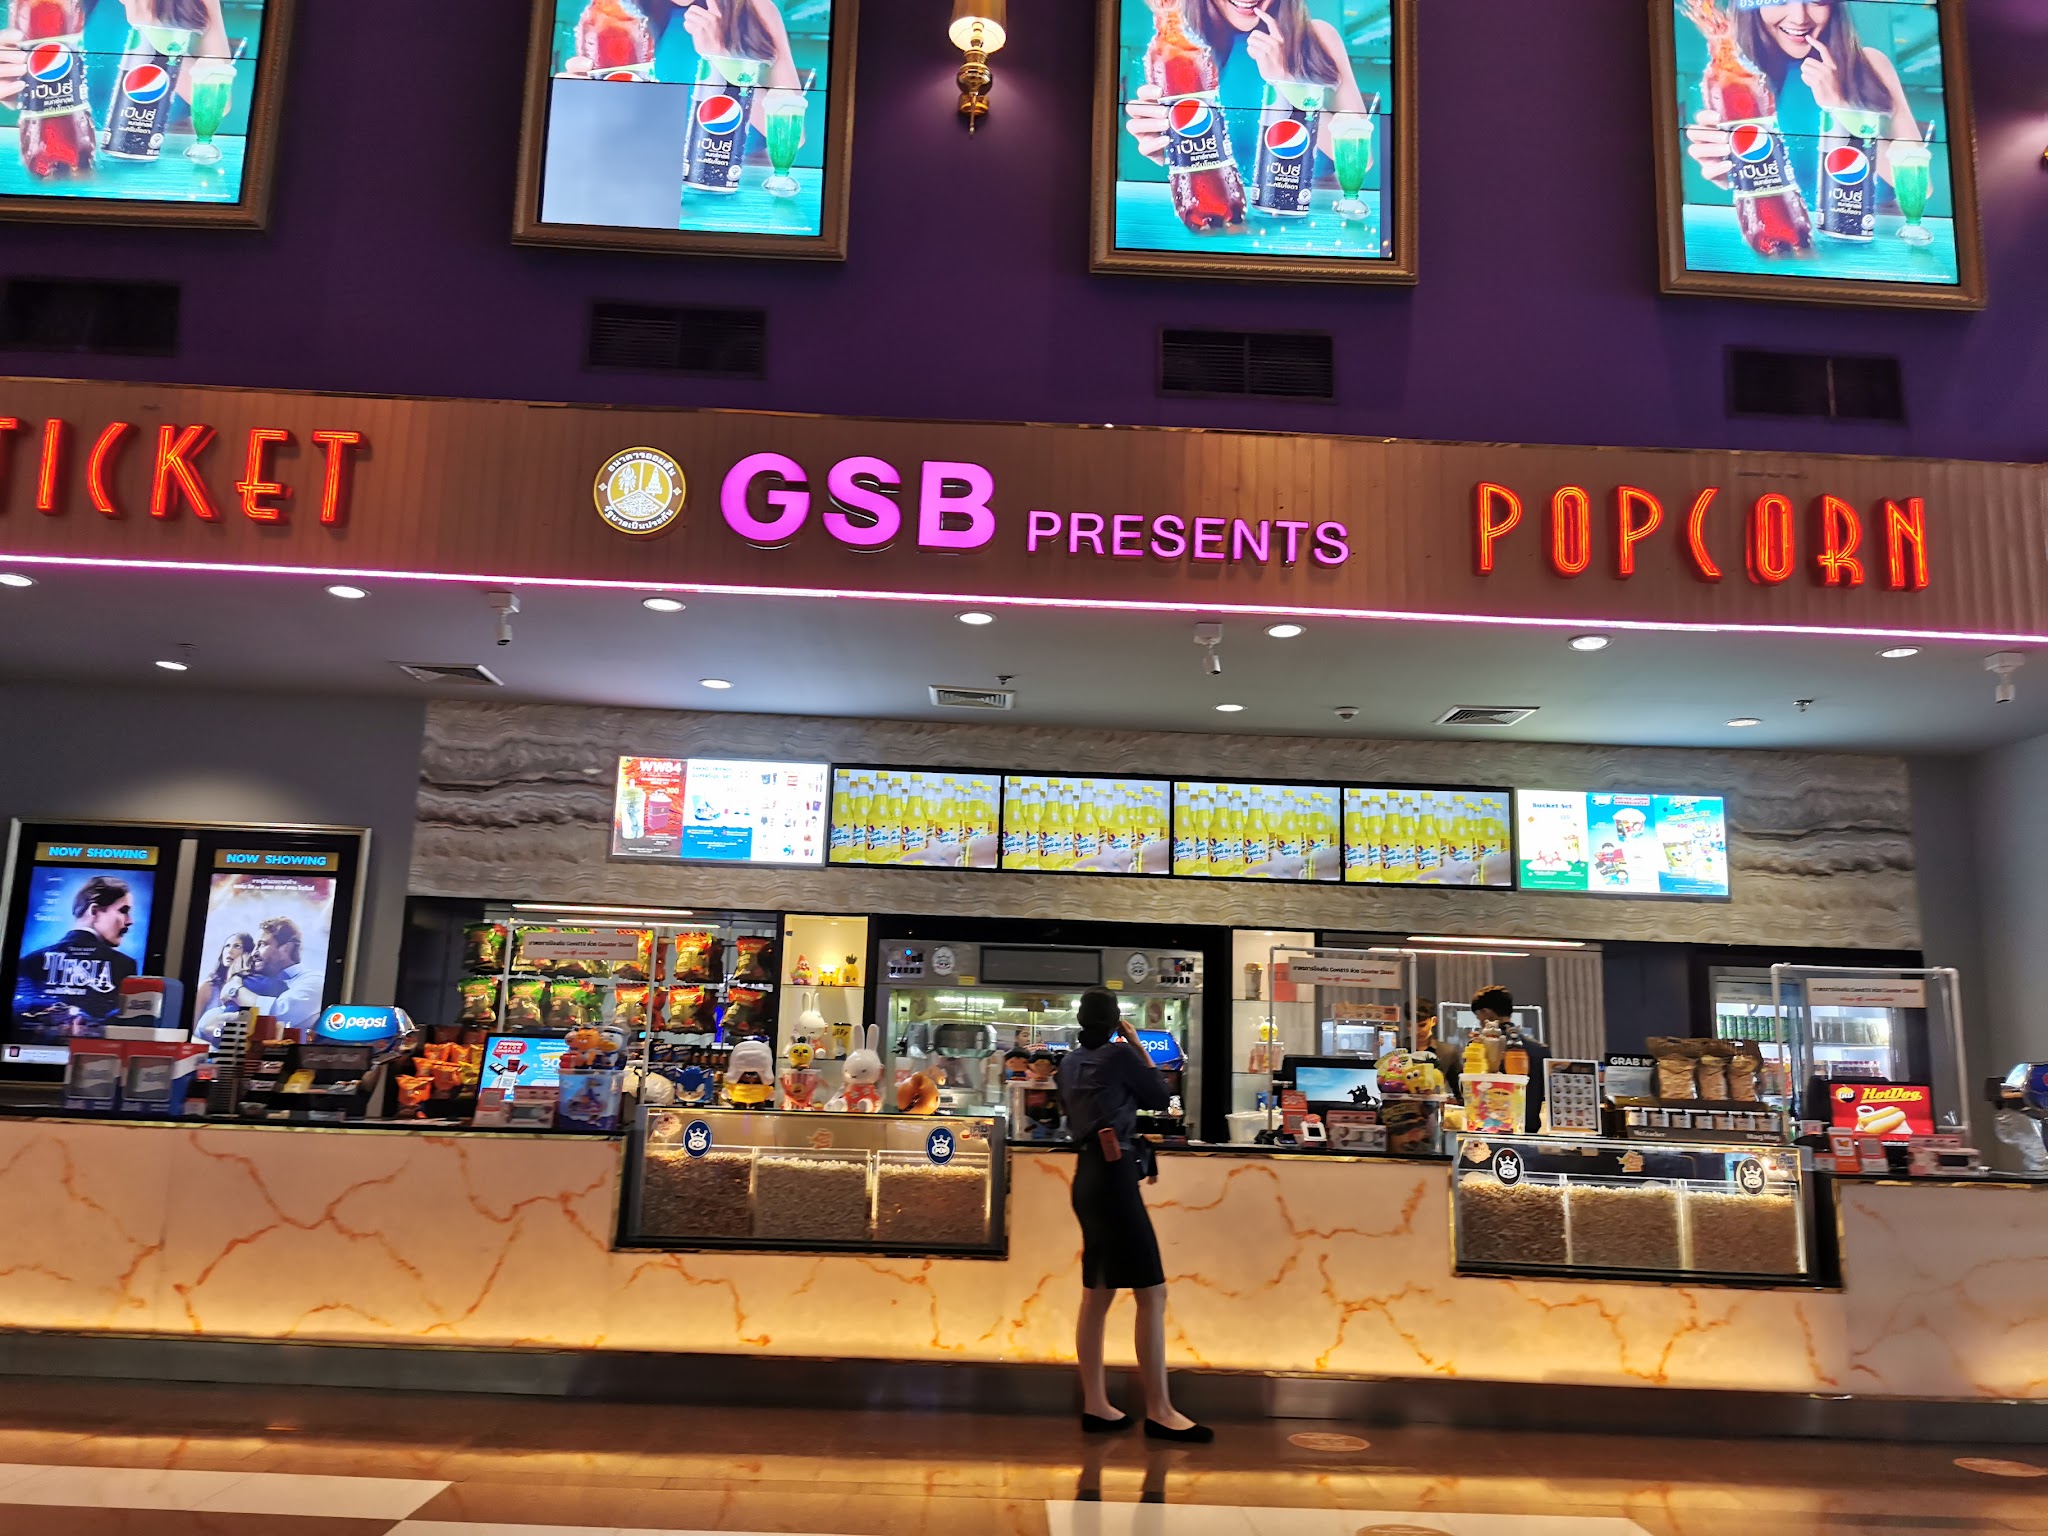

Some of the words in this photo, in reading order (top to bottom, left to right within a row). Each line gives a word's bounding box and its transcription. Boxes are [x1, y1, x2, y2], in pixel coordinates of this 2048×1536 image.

[1176, 135, 1218, 154] เป๊ปซี่
[1266, 162, 1301, 176] เป๊ปซี่
[720, 452, 996, 551] GSB
[1026, 509, 1351, 567] PRESENTS
[1475, 481, 1929, 591] POPCORN
[640, 761, 682, 772] WW84
[48, 846, 83, 857] NOW
[87, 847, 148, 860] SHOWING
[226, 853, 260, 864] NOW
[265, 854, 327, 866] SHOWING
[42, 951, 116, 993] TESLA
[345, 1015, 388, 1030] pepsi
[1142, 1039, 1170, 1053] epsi
[1610, 1056, 1641, 1066] GRAB
[1861, 1087, 1923, 1101] HotDog
